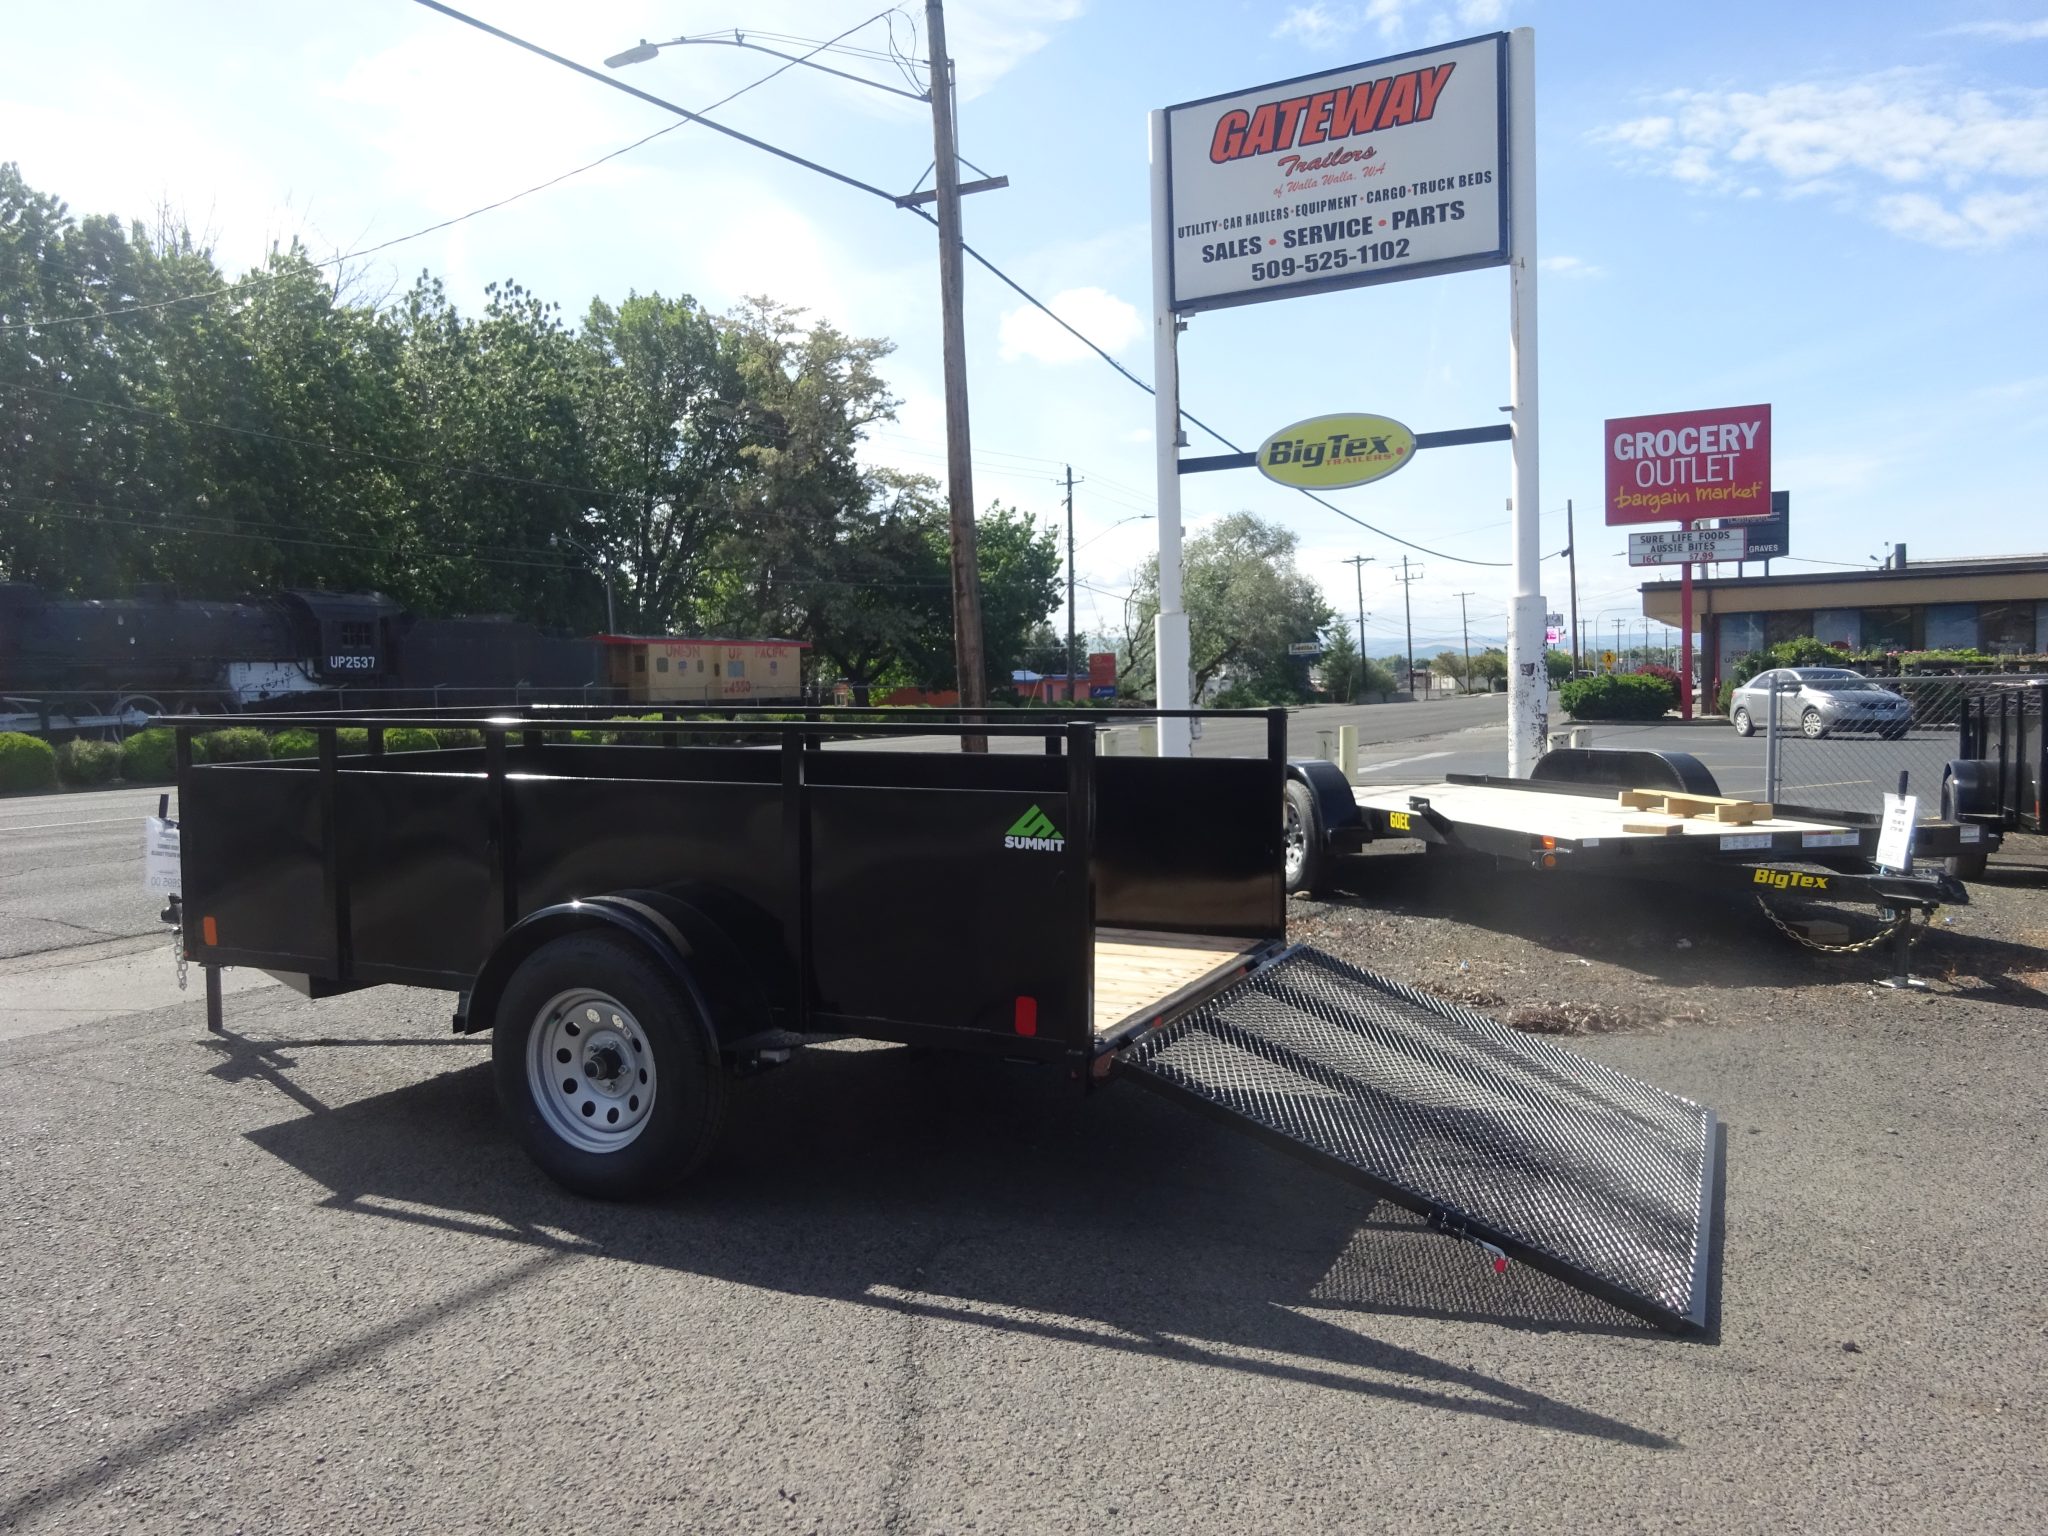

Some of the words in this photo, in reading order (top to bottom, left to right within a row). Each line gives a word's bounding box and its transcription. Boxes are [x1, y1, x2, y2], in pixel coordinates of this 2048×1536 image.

[1209, 62, 1456, 164] GATEWAY
[1277, 146, 1377, 177] Trailers
[1273, 184, 1283, 198] of
[1286, 179, 1317, 193] Walla
[1362, 162, 1386, 178] WA
[1178, 220, 1218, 238] UTILITY
[1223, 216, 1242, 230] CAR
[1246, 207, 1289, 226] HAULERS
[1295, 194, 1357, 217] EQUIPMENT
[1366, 185, 1406, 204] CARGO
[1411, 177, 1455, 196] TRUCK
[1458, 170, 1492, 188] BEDS
[1202, 236, 1262, 263] SALES
[1283, 216, 1373, 249] SERVICE
[1392, 200, 1465, 230] PARTS
[1251, 238, 1410, 282] 509-525-1102
[1267, 433, 1393, 468] BigTex
[1613, 421, 1762, 461] GROCERY
[1326, 454, 1393, 466] TRAILERS
[1636, 453, 1740, 488] OUTLET
[1613, 486, 1690, 513] bargain
[1696, 482, 1761, 501] market
[1640, 535, 1664, 544] SURE
[1671, 533, 1692, 542] LIFE
[1699, 531, 1730, 540] FOODS
[1650, 543, 1682, 553] AUSSIE
[1688, 542, 1715, 551] BITES
[1748, 544, 1779, 553] GRAVES
[1642, 554, 1663, 563] 16CT
[1689, 551, 1714, 560] $7.99
[330, 655, 376, 669] UP2537
[1390, 811, 1410, 830] 60EC
[1004, 835, 1065, 852] SUMMIT
[1753, 868, 1829, 889] BigTex
